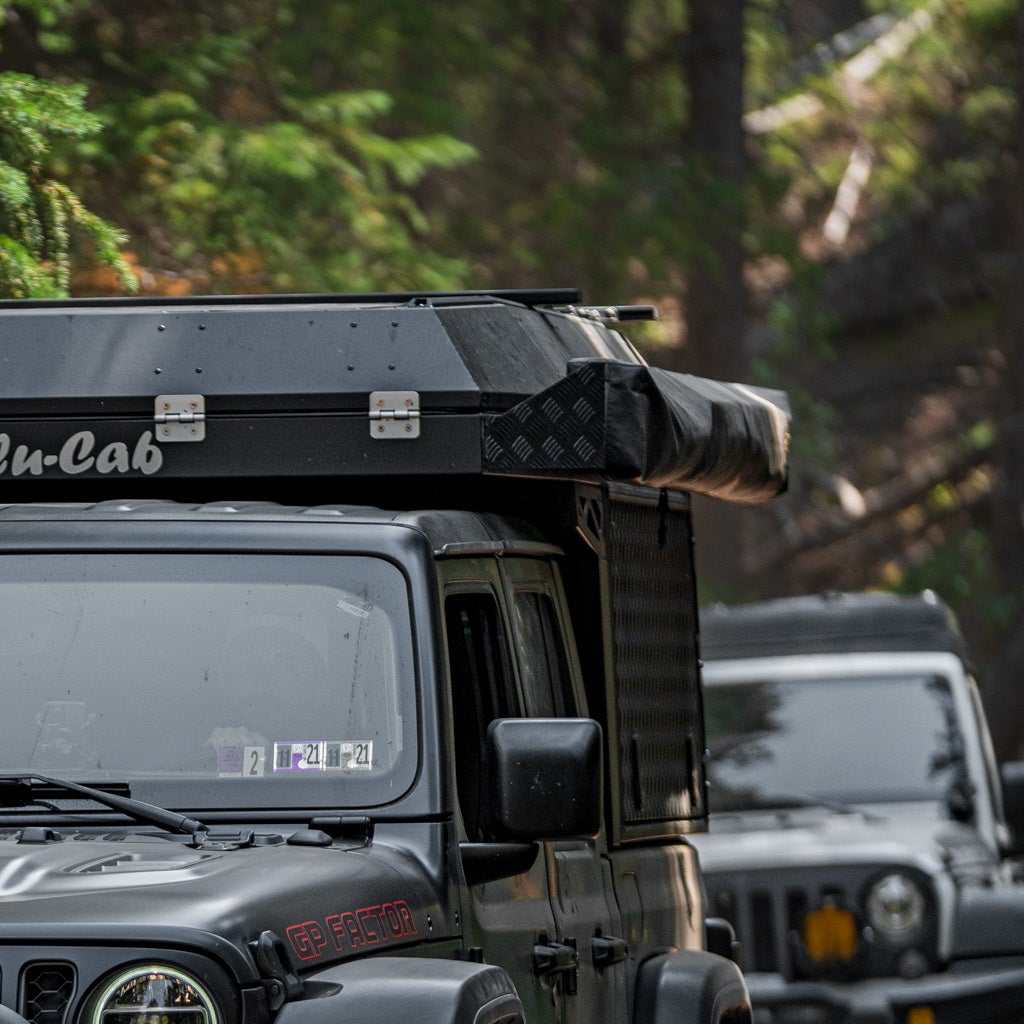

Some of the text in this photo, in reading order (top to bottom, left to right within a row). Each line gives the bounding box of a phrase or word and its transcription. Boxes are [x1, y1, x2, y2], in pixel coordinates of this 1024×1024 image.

[249, 750, 259, 776] 2
[306, 743, 320, 765] 21
[356, 743, 370, 765] 21
[285, 900, 418, 961] GP FACTOR
